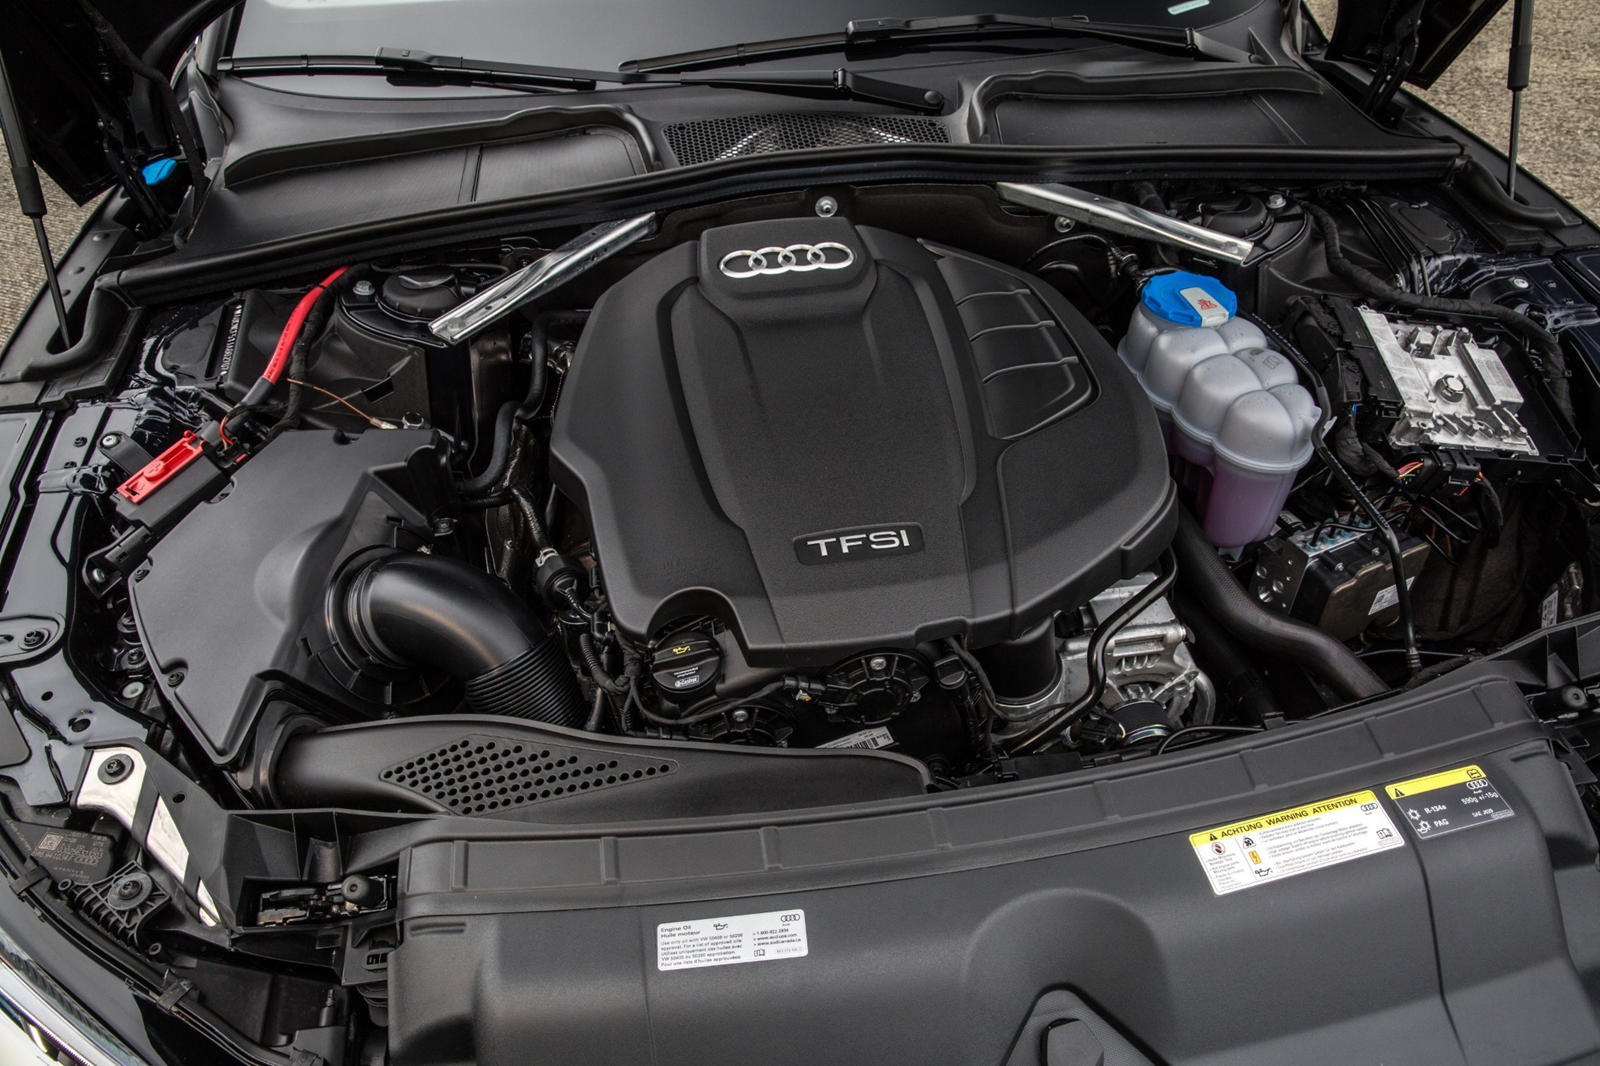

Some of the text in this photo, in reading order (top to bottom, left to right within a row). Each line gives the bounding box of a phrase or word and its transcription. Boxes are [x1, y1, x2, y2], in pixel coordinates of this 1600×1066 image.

[807, 529, 910, 557] TFSI
[1219, 821, 1263, 838] ACHTUNG
[1265, 809, 1309, 826] WARNING
[1310, 796, 1358, 814] ATTENTION
[1423, 803, 1447, 814] R-134a
[1432, 818, 1449, 827] PAG
